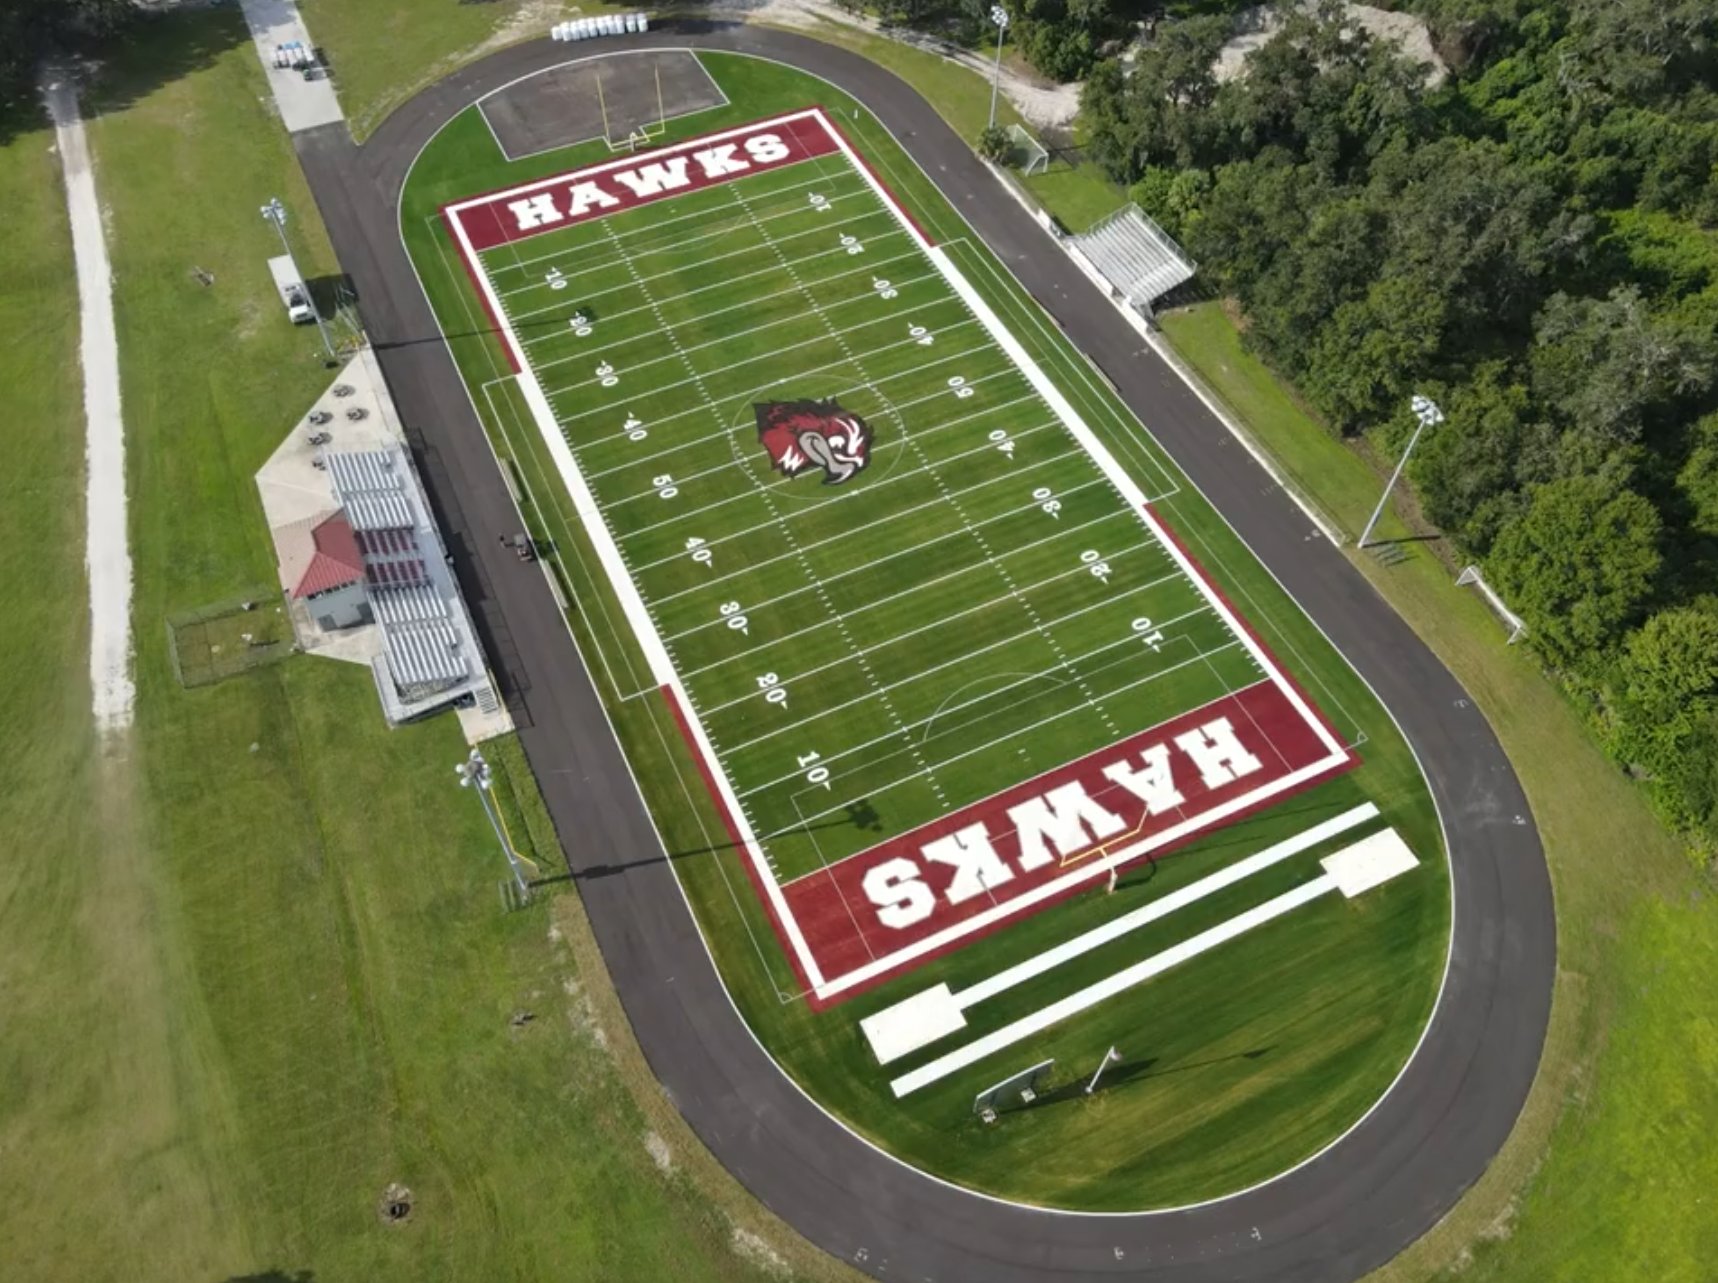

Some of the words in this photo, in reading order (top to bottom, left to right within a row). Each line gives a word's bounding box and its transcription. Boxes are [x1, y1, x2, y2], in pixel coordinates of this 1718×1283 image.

[507, 133, 790, 231] HAWKS
[810, 193, 832, 212] 10
[841, 235, 864, 255] 20
[546, 269, 568, 290] 10
[875, 279, 898, 299] 30
[909, 326, 934, 347] 40
[596, 364, 619, 387] 30
[948, 376, 974, 397] 50
[623, 419, 647, 441] 40
[989, 431, 1015, 452] 40
[653, 474, 678, 499] 50
[1033, 488, 1061, 512] 30
[686, 538, 711, 562] 40
[1081, 551, 1112, 577] 20
[720, 601, 748, 630] 30
[1132, 618, 1163, 645] 10
[757, 672, 786, 703] 20
[797, 752, 829, 783] 10
[861, 716, 1264, 930] HAWKS
